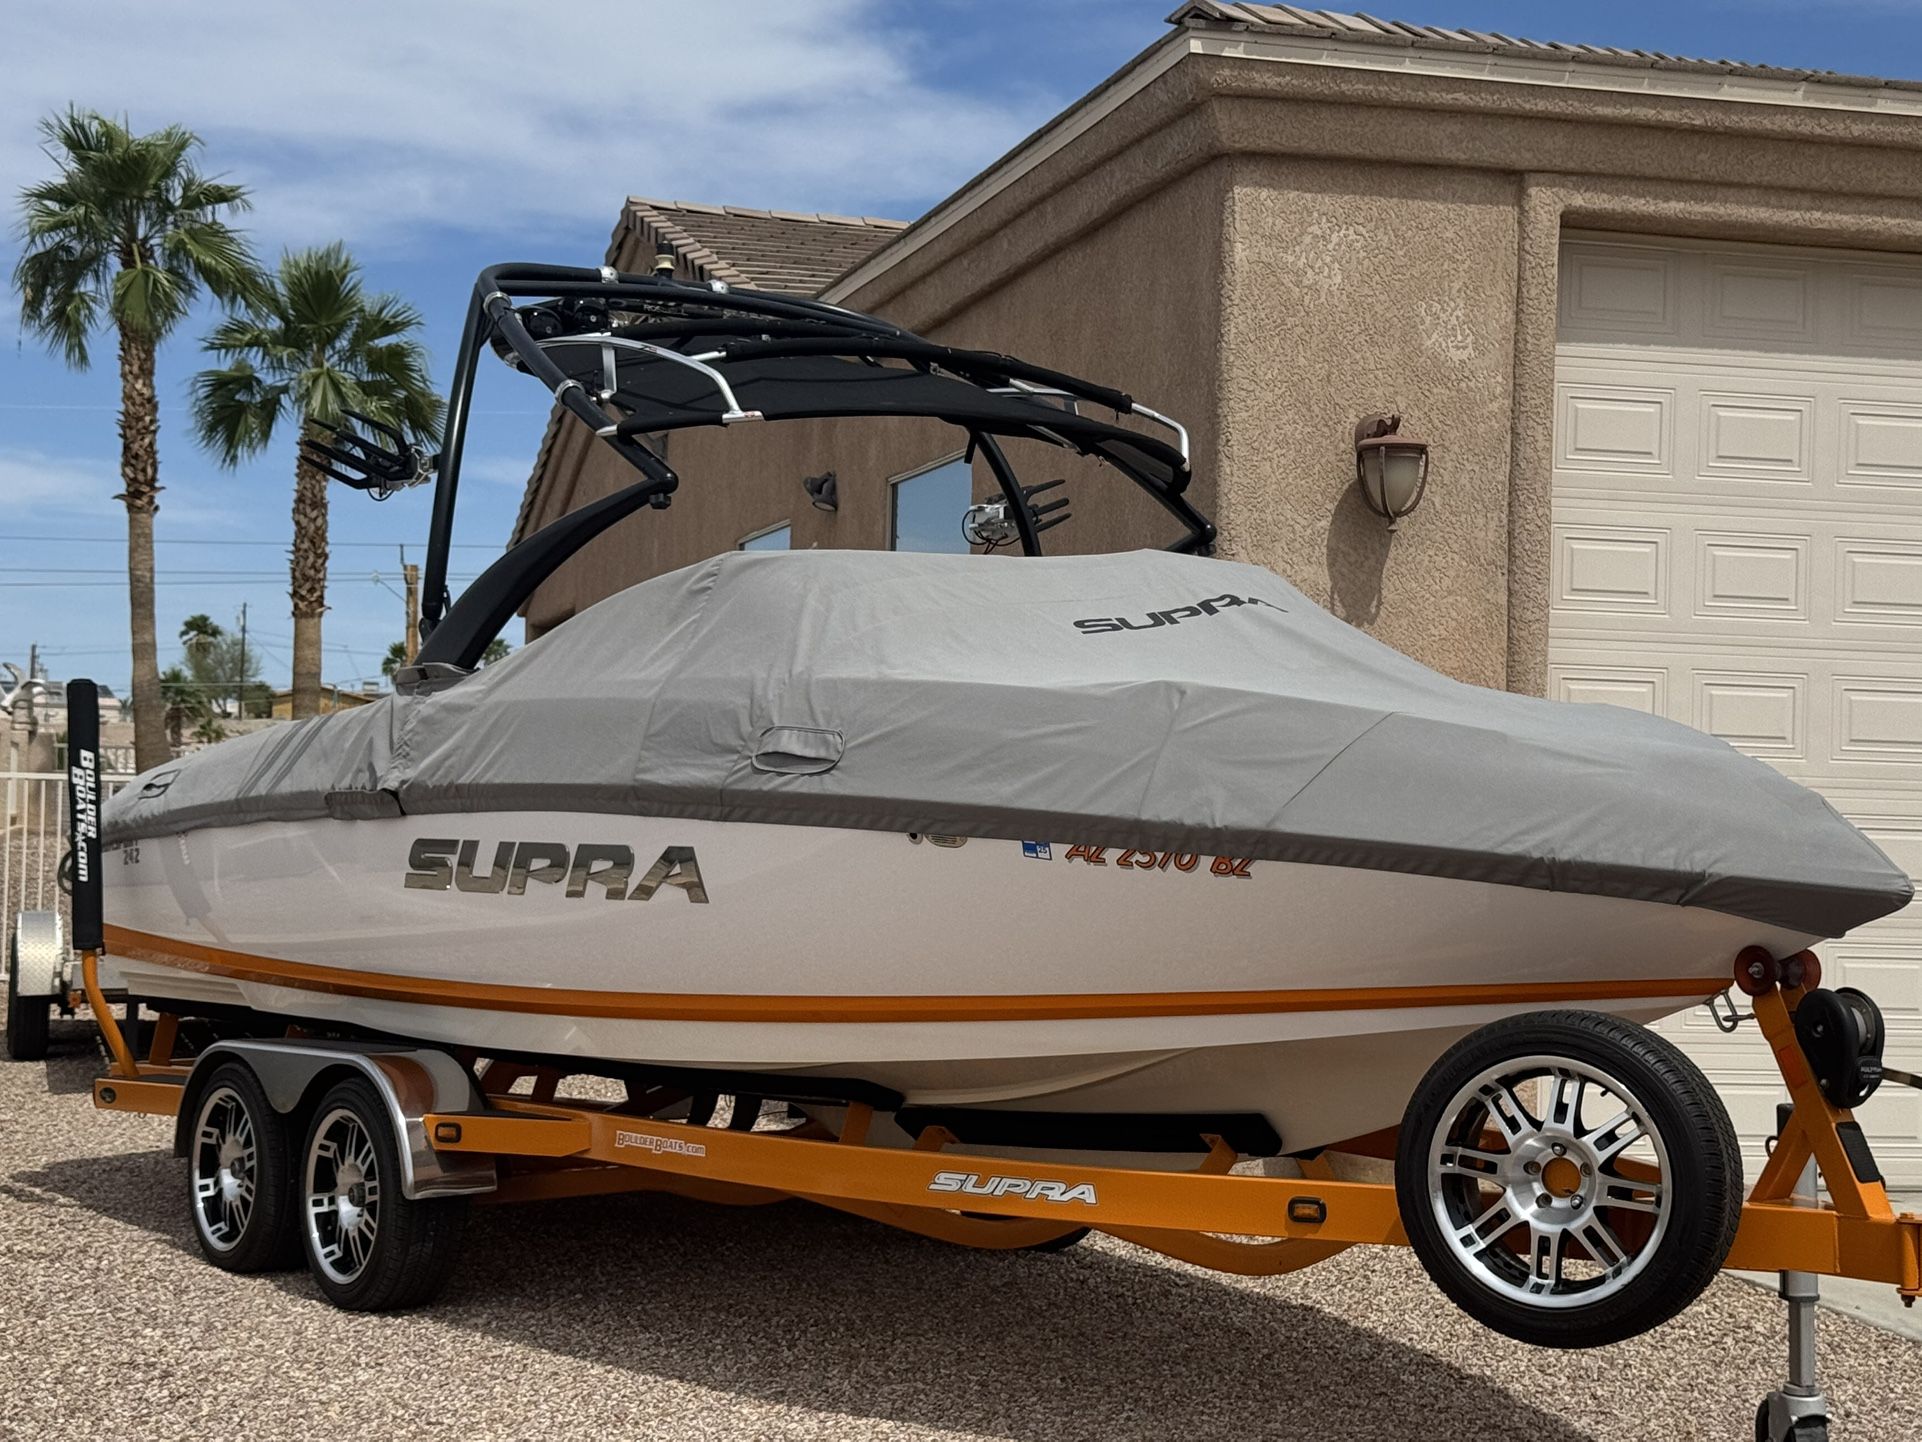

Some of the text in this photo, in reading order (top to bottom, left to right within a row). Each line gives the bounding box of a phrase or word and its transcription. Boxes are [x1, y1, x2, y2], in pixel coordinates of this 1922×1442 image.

[80, 748, 97, 839] BOULDER
[404, 838, 709, 904] SUPRA
[928, 1171, 1098, 1205] SUPRA
